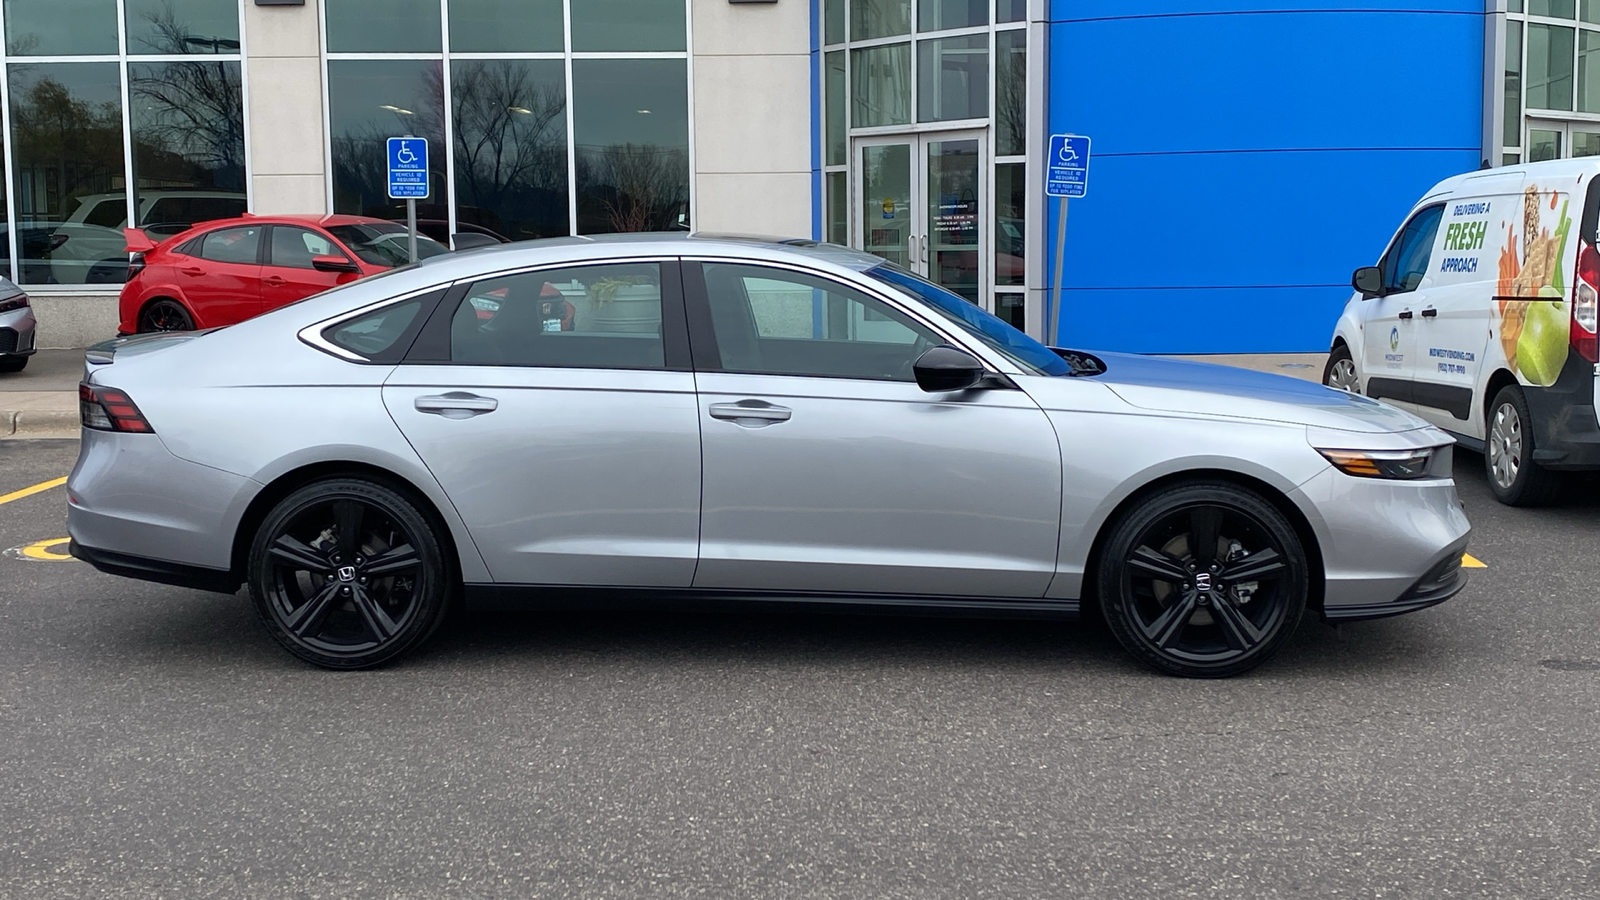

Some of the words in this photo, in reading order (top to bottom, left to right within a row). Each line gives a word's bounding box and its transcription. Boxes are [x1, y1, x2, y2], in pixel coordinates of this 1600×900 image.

[1454, 202, 1486, 216] DELIVERING
[1484, 202, 1491, 213] A
[1443, 221, 1488, 250] FRESH
[1440, 258, 1478, 272] APPROACH
[1429, 348, 1475, 362] MIDWESTVENDING.COM
